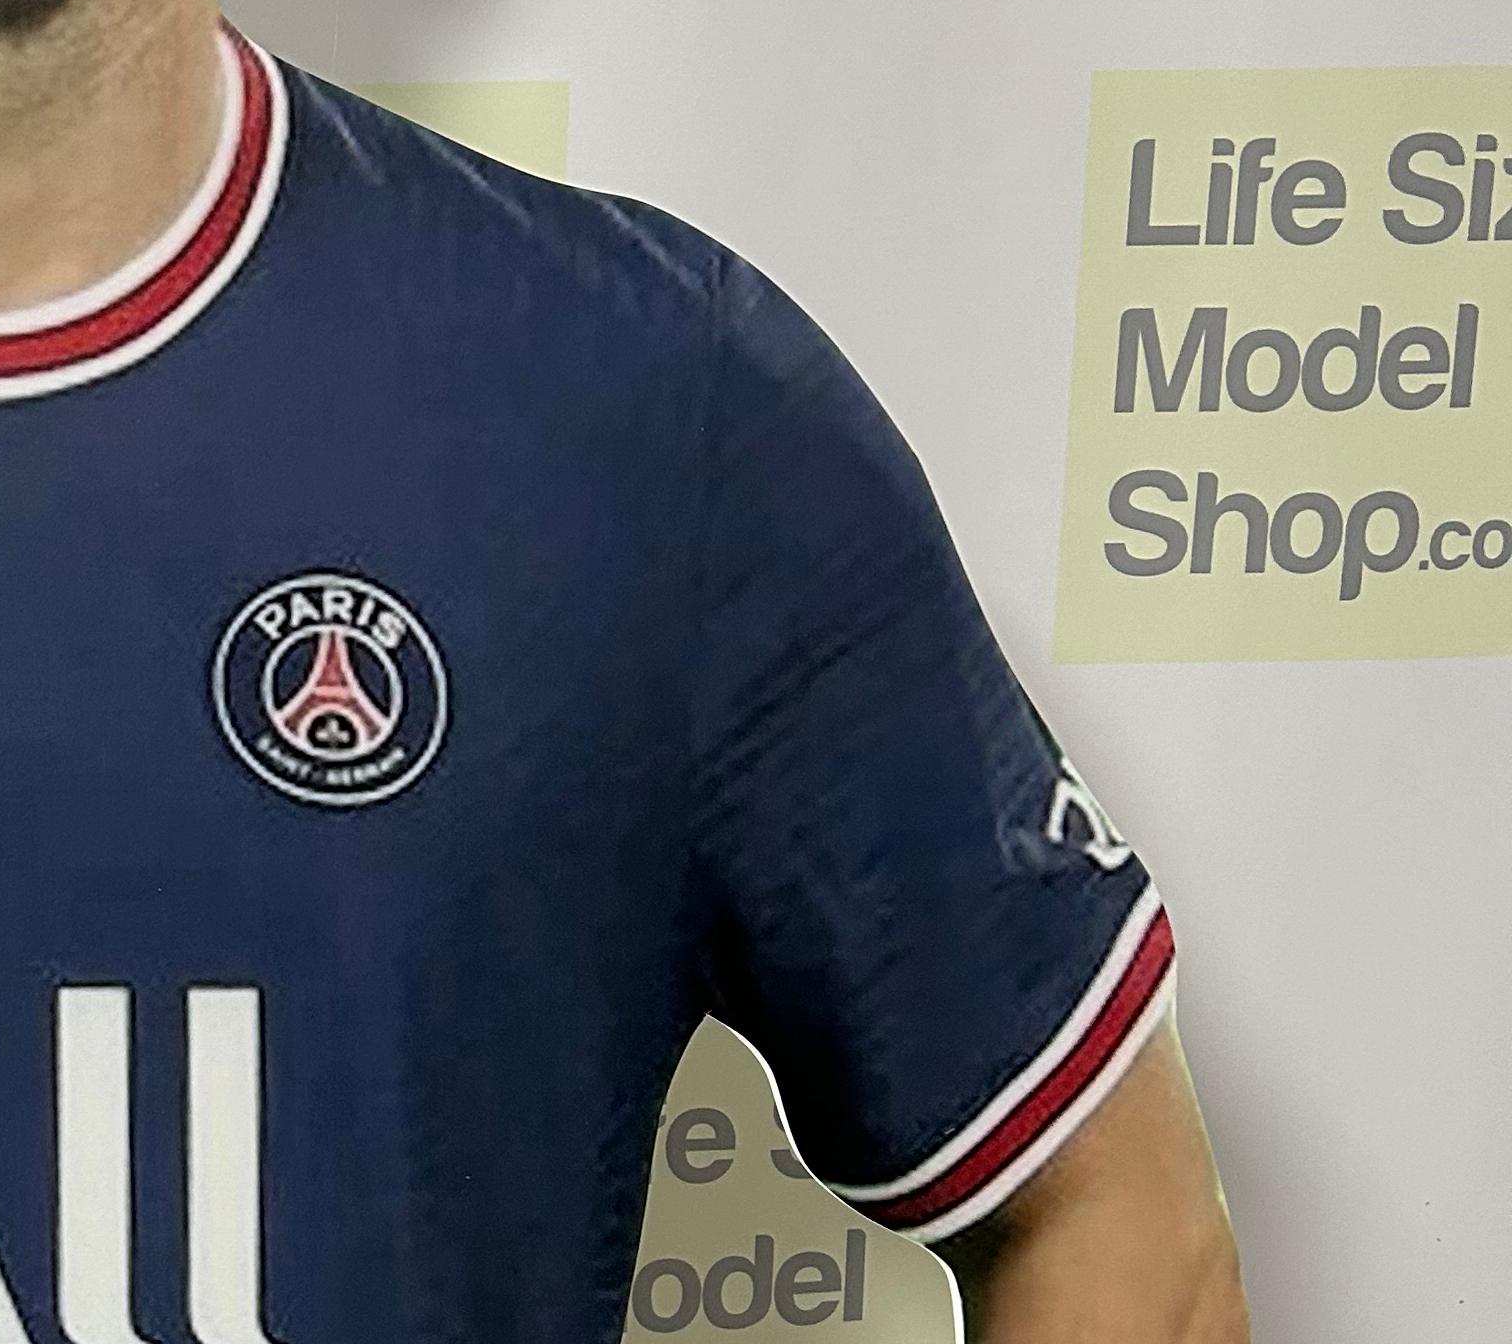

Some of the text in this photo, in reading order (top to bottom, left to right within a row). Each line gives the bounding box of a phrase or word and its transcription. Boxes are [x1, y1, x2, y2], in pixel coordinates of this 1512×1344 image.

[1126, 137, 1346, 247] Life
[1113, 303, 1479, 413] Model
[253, 588, 408, 649] PARIS
[629, 1228, 867, 1334] odel
